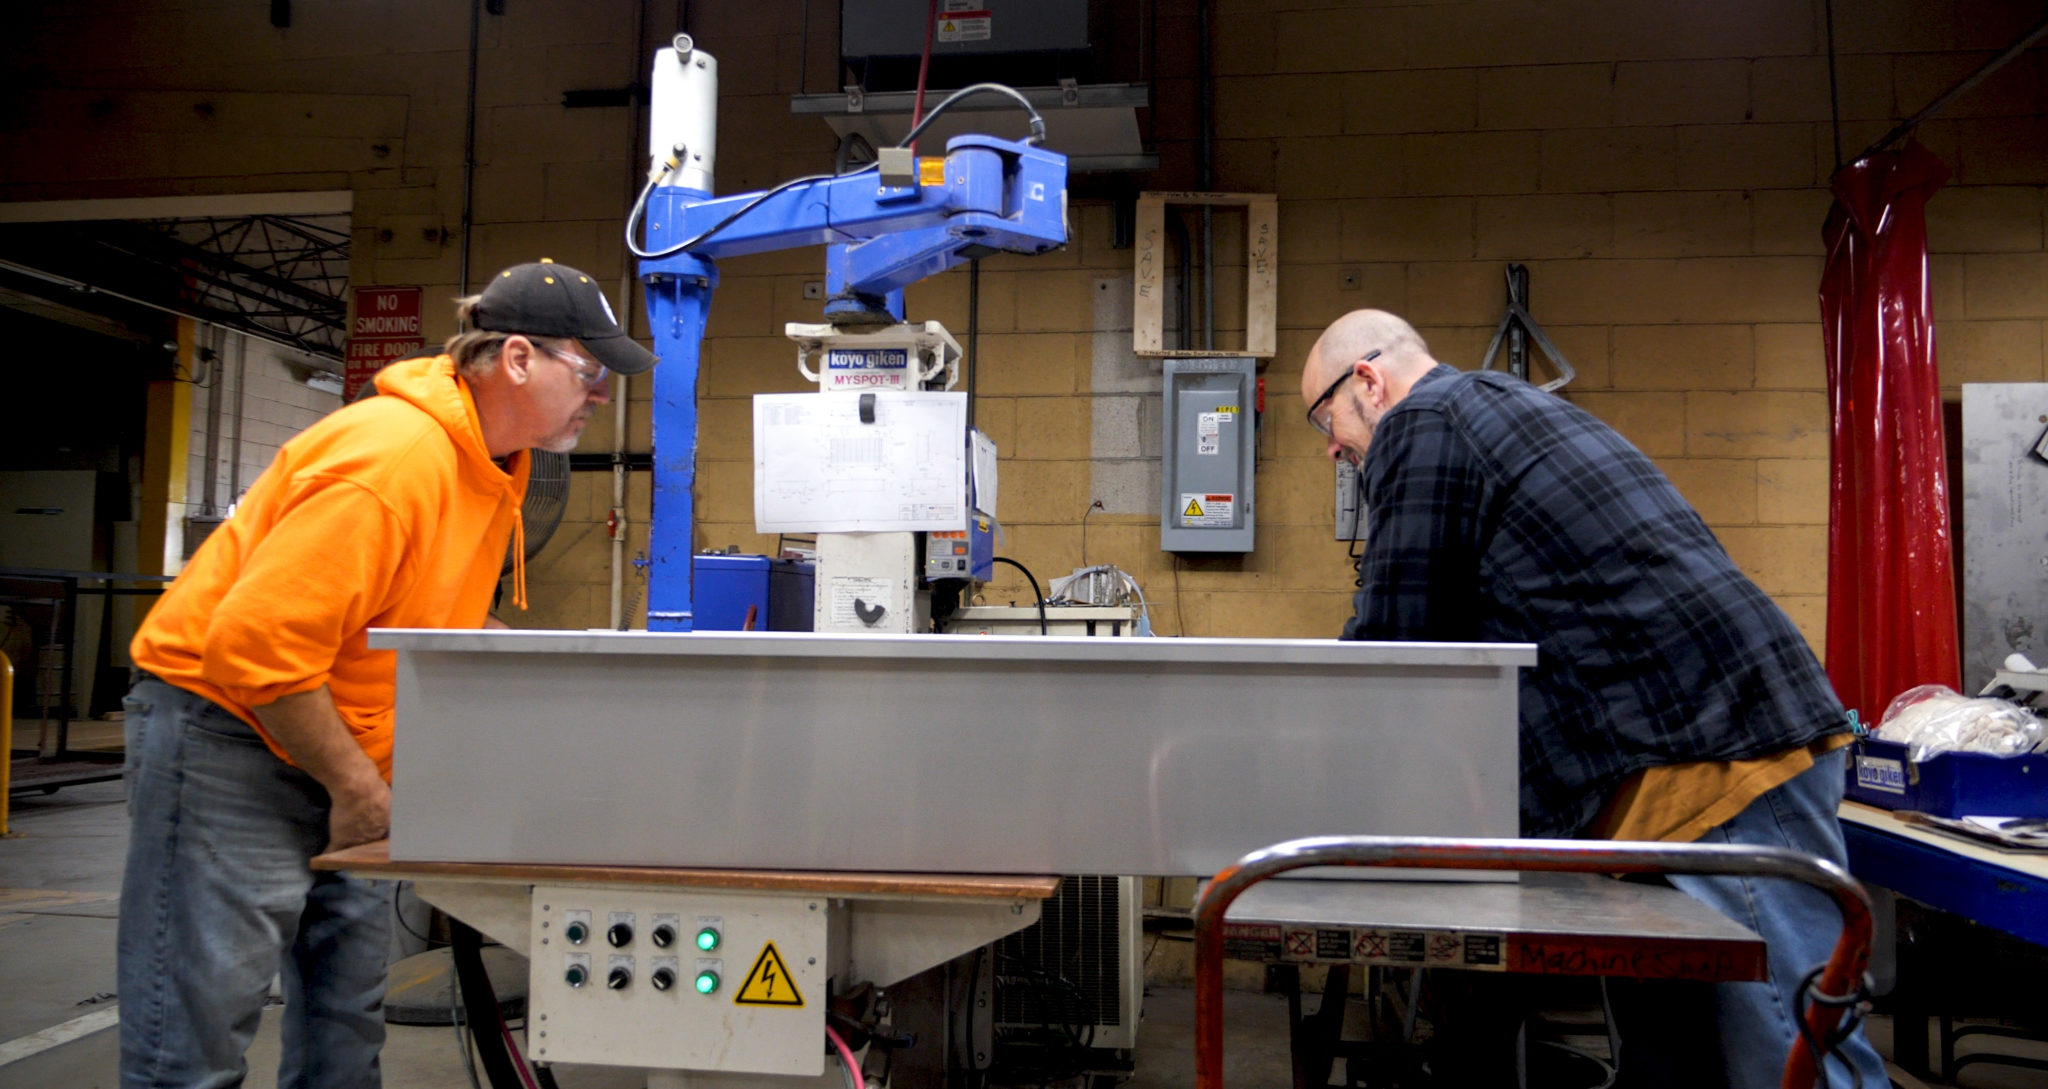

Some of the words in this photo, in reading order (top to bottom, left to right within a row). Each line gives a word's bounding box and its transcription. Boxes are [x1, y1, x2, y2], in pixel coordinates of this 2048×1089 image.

[1256, 223, 1269, 275] SAVE
[377, 294, 398, 311] NO
[356, 316, 418, 333] SMOKING
[351, 343, 380, 357] FIRE
[830, 351, 863, 368] koyo
[866, 350, 905, 368] giken
[1202, 415, 1214, 423] ON
[1200, 445, 1215, 453] OFF
[1858, 765, 1878, 781] koyo
[1520, 945, 1645, 976] Machine
